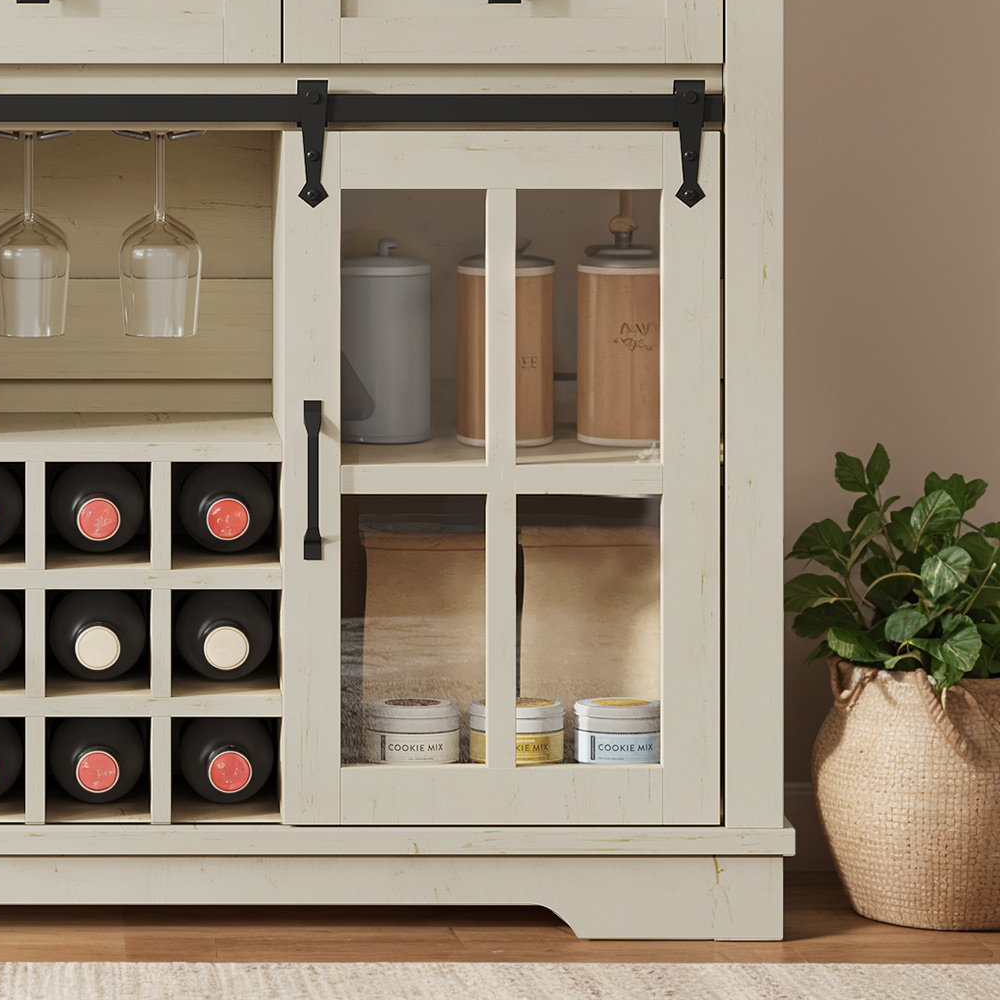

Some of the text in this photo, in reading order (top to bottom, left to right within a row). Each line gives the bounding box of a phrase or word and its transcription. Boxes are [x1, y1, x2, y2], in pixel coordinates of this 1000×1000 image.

[388, 743, 444, 752] COOKIE MIX
[515, 743, 549, 752] KIE MIX
[598, 743, 654, 752] COOKIE MIX
